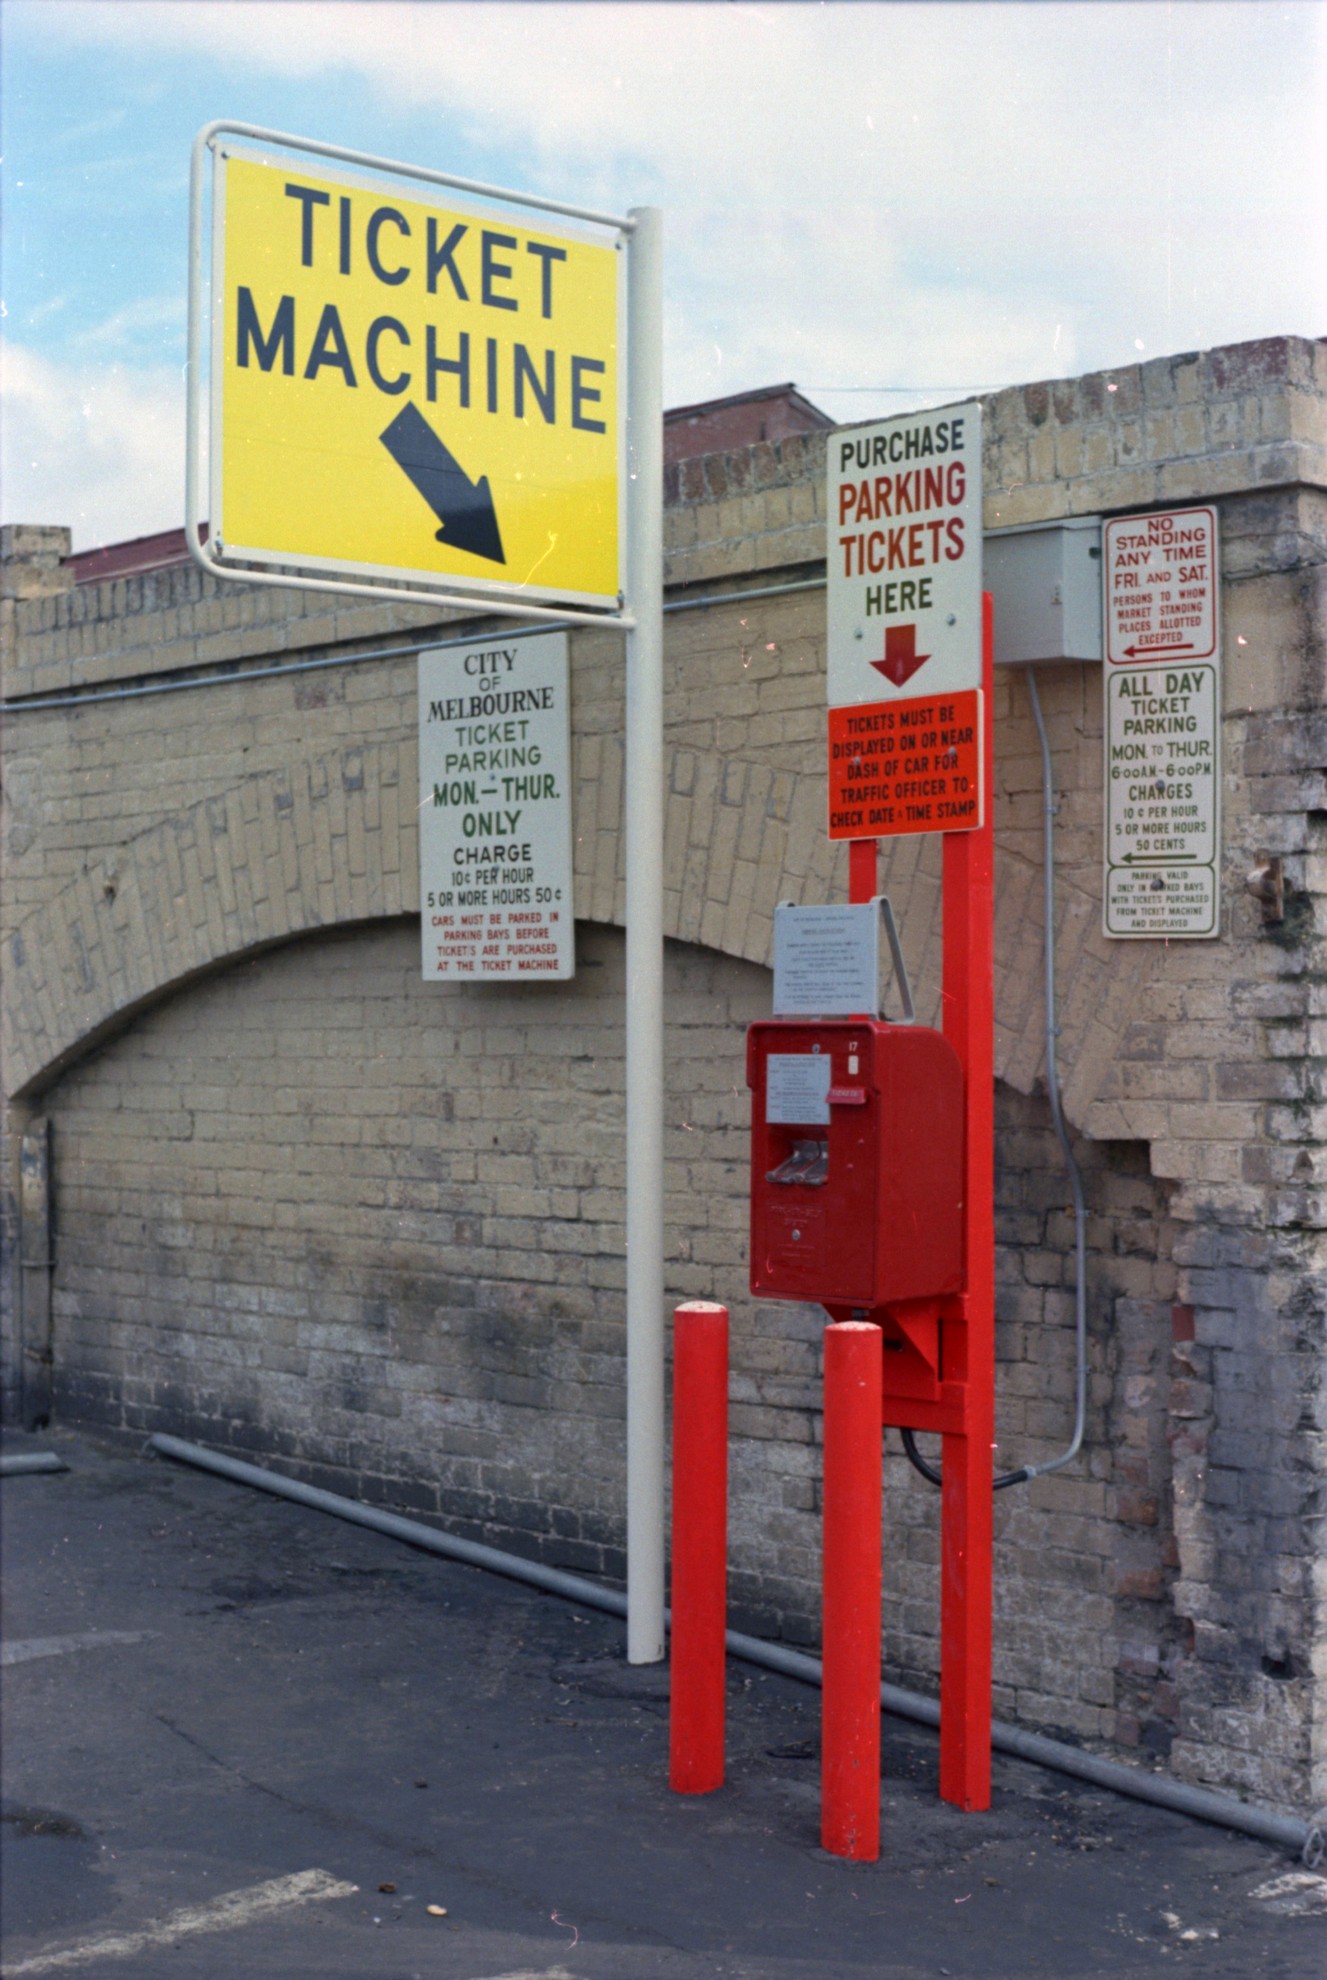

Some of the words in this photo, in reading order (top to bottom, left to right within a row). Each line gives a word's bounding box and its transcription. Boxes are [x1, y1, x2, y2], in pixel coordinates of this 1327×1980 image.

[284, 182, 567, 319] TICKET
[236, 285, 607, 434] MACHINE
[841, 419, 965, 473] PURCHASE
[839, 461, 966, 526] PARKING
[1148, 517, 1173, 532] NO
[839, 517, 965, 578] TICKETS
[1115, 528, 1206, 550] STANDING
[1115, 551, 1151, 568] ANY
[1162, 544, 1207, 562] TIME
[1146, 571, 1171, 584] AND
[1178, 564, 1208, 583] SAT.
[866, 577, 933, 616] HERE
[1113, 593, 1153, 606] PERSONS
[1160, 591, 1171, 601] TO
[1179, 588, 1206, 599] WHOM
[1117, 607, 1151, 619] MARKET
[1160, 602, 1203, 615] STANDING
[1119, 621, 1151, 633] PLACES
[1159, 616, 1201, 630] ALLOTTED
[1139, 632, 1183, 645] EXCEPTED
[463, 648, 518, 676] CITY
[479, 676, 501, 692] OF
[1118, 675, 1153, 698] ALL
[1166, 671, 1205, 694] DAY
[427, 686, 555, 723] MELBOURNE
[1131, 697, 1190, 716] TICKET
[847, 714, 895, 734] TICKETS
[900, 708, 934, 727] MUST
[939, 706, 955, 722] BE
[1123, 715, 1197, 736] PARKING
[455, 720, 530, 747] TICKET
[832, 737, 895, 759] DISPLAYED
[901, 735, 916, 751] ON
[921, 732, 937, 748] OR
[941, 727, 973, 746] NEAR
[445, 745, 542, 774] PARKING
[1112, 743, 1148, 761] MON.
[1151, 745, 1163, 756] TO
[1166, 740, 1212, 758] THUR.
[847, 762, 879, 780] DASH
[884, 759, 899, 777] OF
[905, 756, 929, 774] CAR
[934, 753, 959, 771] FOR
[840, 784, 890, 804] TRAFFIC
[895, 779, 946, 799] OFFICER
[952, 776, 968, 793] TO
[1129, 783, 1193, 801] CHARGES
[830, 810, 864, 828] CHECK
[869, 807, 894, 824] DATE
[905, 804, 931, 821] TIME
[937, 800, 976, 818] STAMP
[1148, 806, 1167, 818] PER
[1171, 805, 1198, 817] HOUR
[462, 810, 522, 838] ONLY
[1115, 824, 1122, 835] 5
[1125, 823, 1139, 835] OR
[1142, 823, 1169, 834] MORE
[1173, 822, 1207, 833] HOURS
[453, 843, 532, 865] CHARGE
[1136, 839, 1150, 851] 50
[1154, 838, 1185, 850] CENTS
[475, 869, 498, 885] PER
[502, 867, 534, 884] HOUR
[1131, 871, 1161, 880] PARKING
[1166, 871, 1189, 880] VALID
[427, 892, 435, 907] 5
[438, 891, 454, 907] OR
[458, 890, 488, 906] MORE
[492, 888, 531, 905] HOURS
[1117, 884, 1134, 893] ONLY
[1138, 884, 1146, 892] IN
[1150, 883, 1180, 892] RKED
[1184, 882, 1204, 892] BAYS
[1111, 895, 1129, 904] WITH
[1166, 894, 1209, 904] PURCHASED
[432, 916, 455, 926] CARS
[461, 914, 484, 925] MUST
[489, 914, 502, 924] BE
[508, 912, 542, 923] PARKED
[549, 912, 559, 922] IN
[1116, 907, 1137, 916] FROM
[1141, 906, 1165, 916] TICKET
[1169, 906, 1203, 916] MACHINE
[1131, 919, 1146, 928] AND
[1149, 919, 1188, 928] DISPLAYED
[444, 930, 482, 940] PARKING
[487, 929, 510, 940] BAYS
[516, 928, 550, 939] BEFORE
[482, 945, 500, 955] ARE
[507, 943, 558, 955] PURCHASED
[437, 961, 449, 971] AT
[456, 961, 475, 971] THE
[481, 960, 512, 971] TICKET
[518, 959, 559, 971] MACHINE
